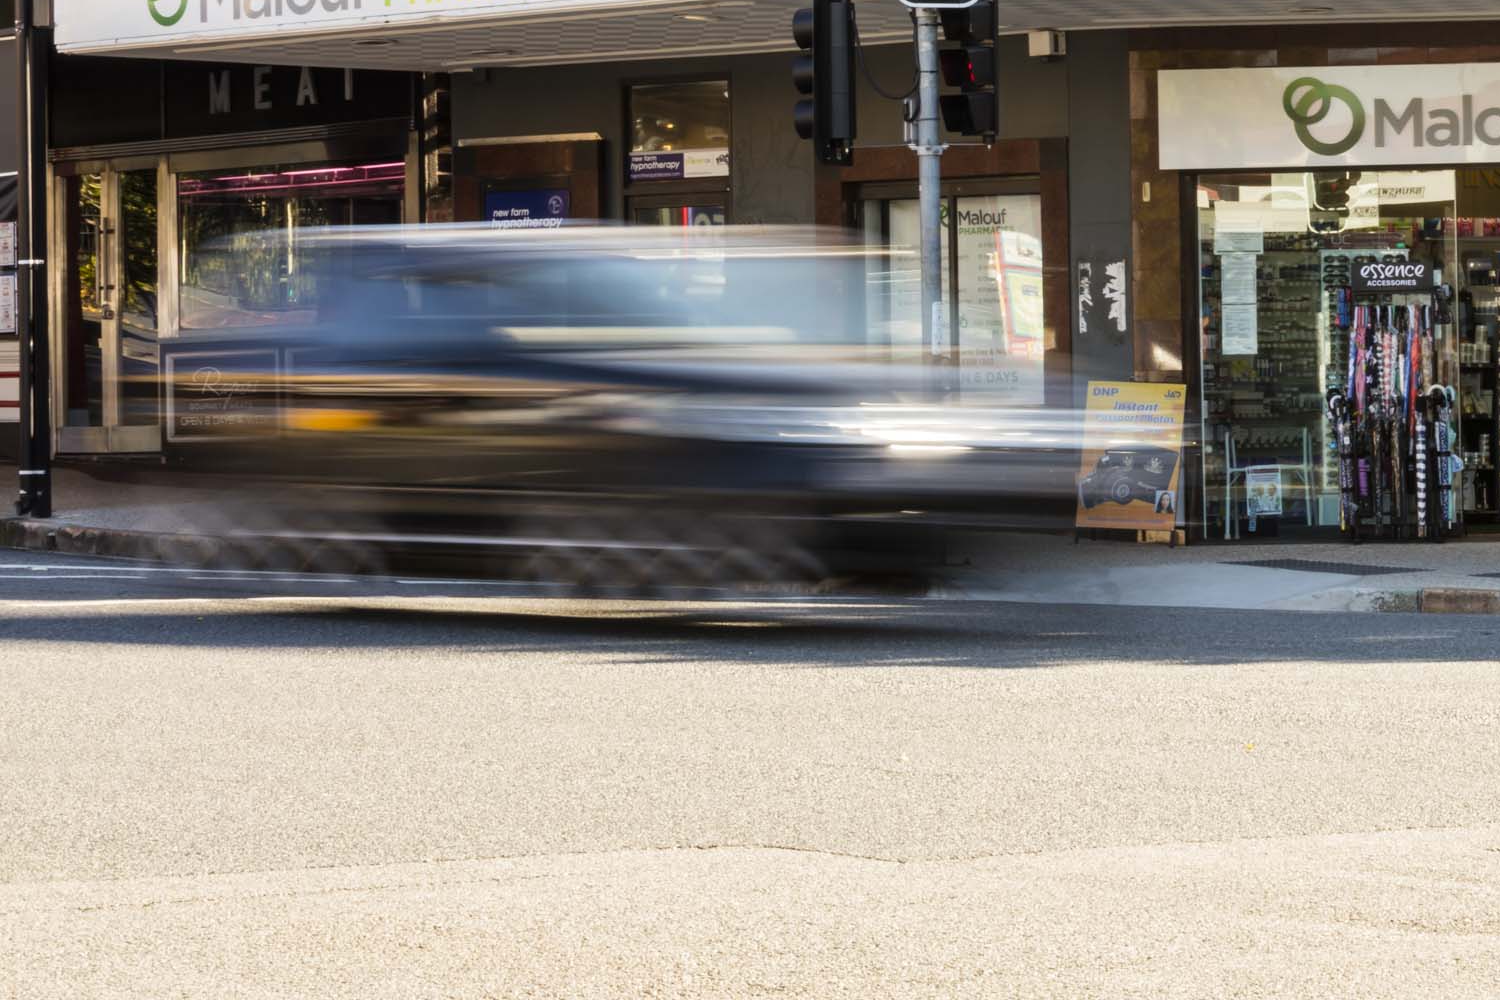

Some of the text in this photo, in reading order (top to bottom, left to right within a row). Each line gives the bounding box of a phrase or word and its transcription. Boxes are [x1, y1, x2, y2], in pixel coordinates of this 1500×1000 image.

[630, 160, 680, 172] hypnotherapy
[493, 207, 530, 218] new farm
[958, 208, 1007, 226] Malouf
[1360, 262, 1426, 280] essence
[1366, 279, 1417, 288] ACCESSORIES
[986, 371, 1019, 384] DAYS
[1092, 387, 1119, 397] DNP
[1113, 400, 1160, 412] Instant
